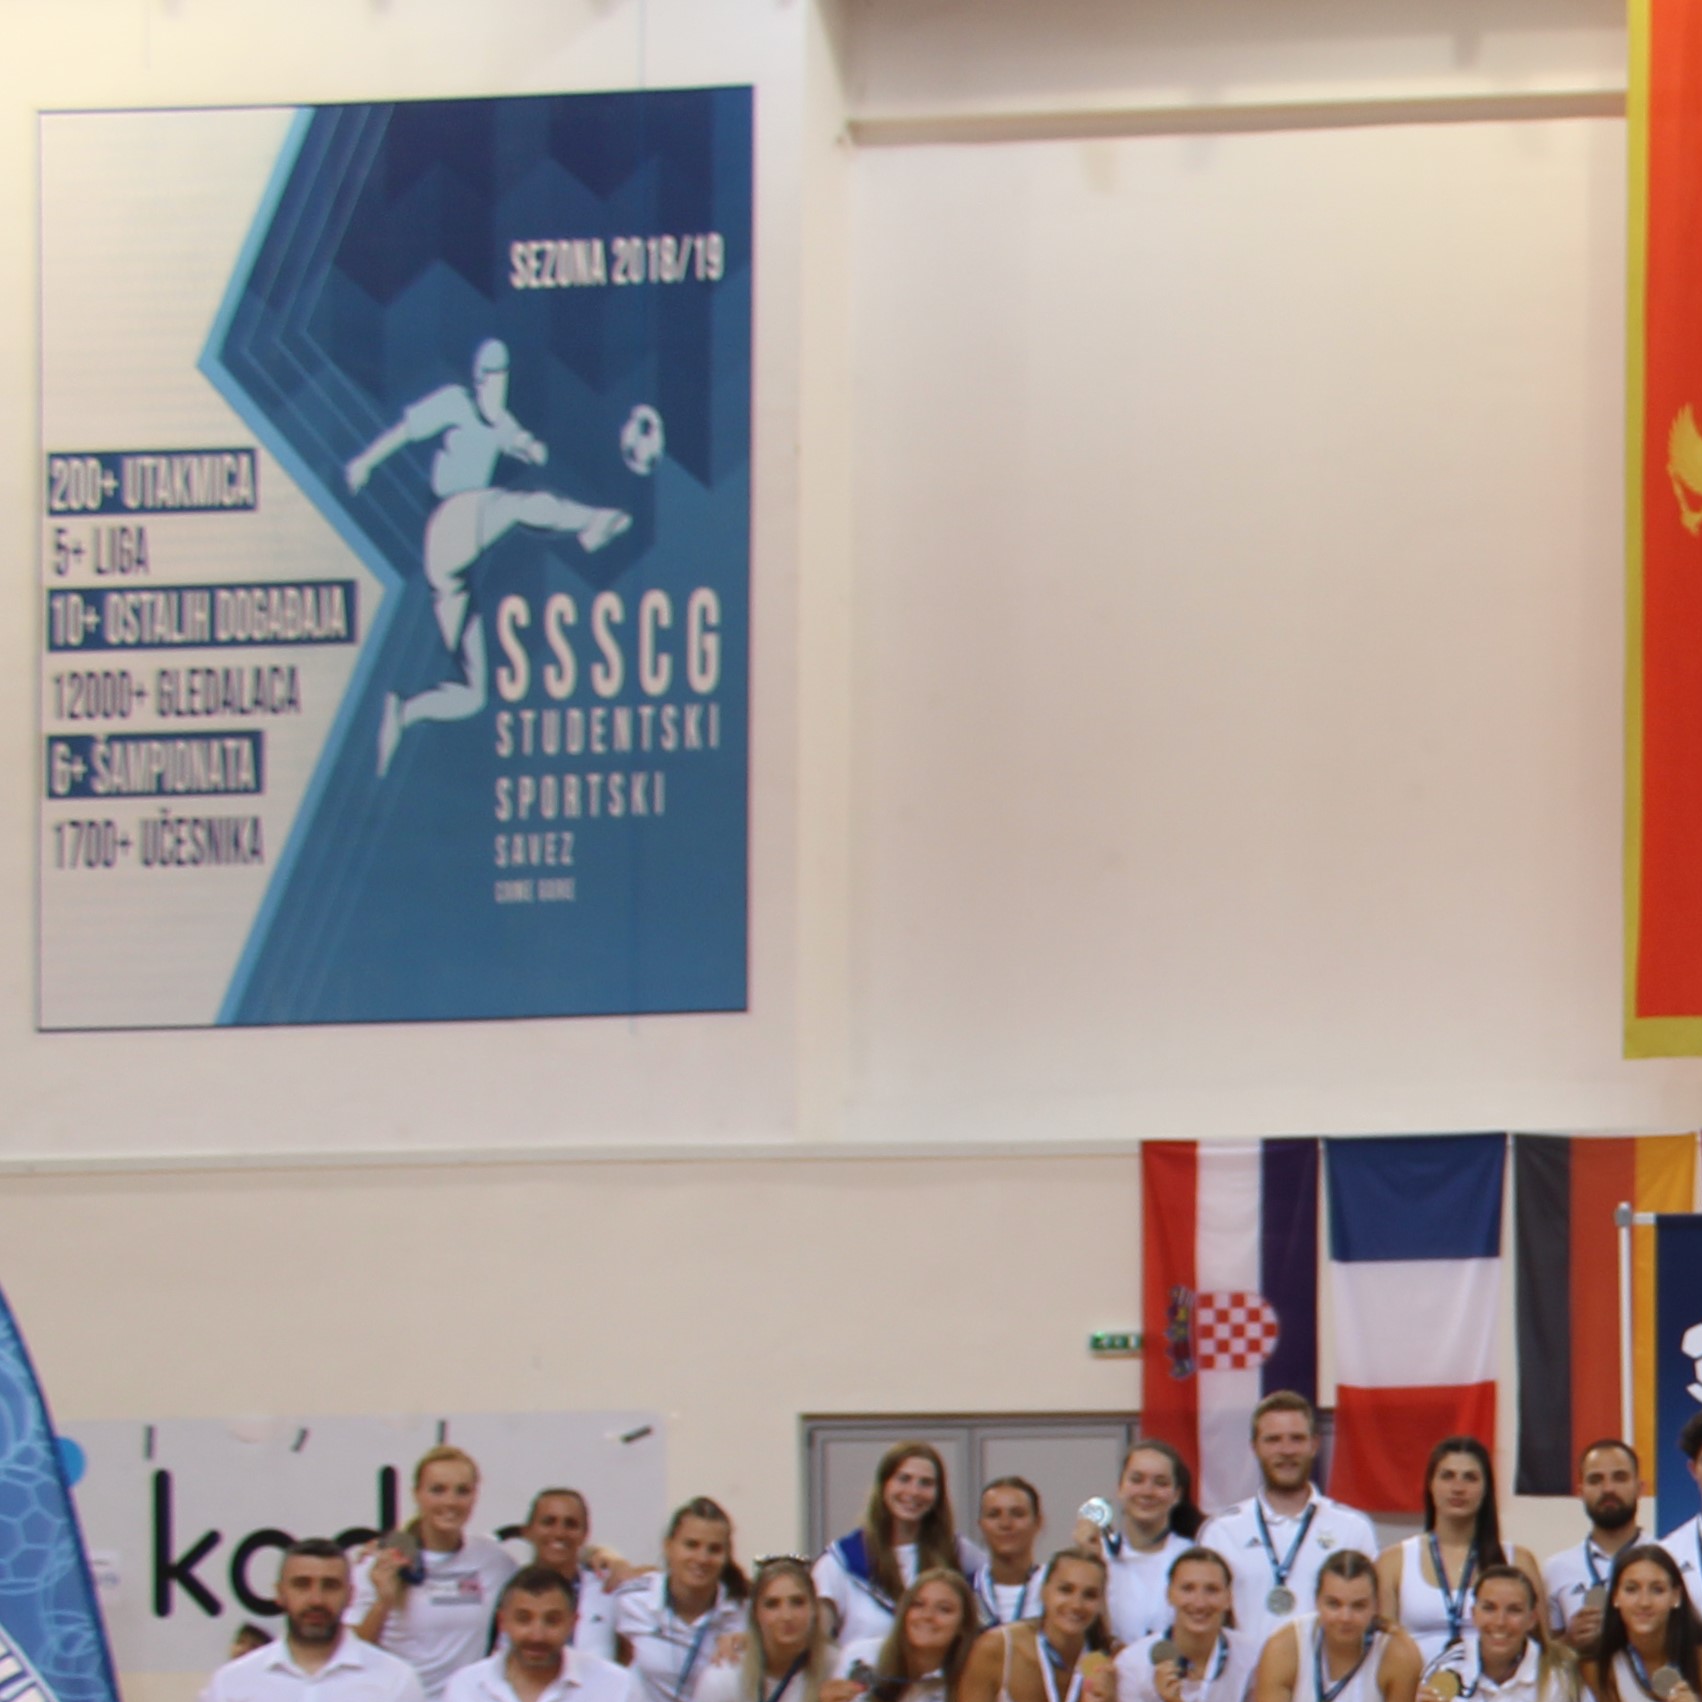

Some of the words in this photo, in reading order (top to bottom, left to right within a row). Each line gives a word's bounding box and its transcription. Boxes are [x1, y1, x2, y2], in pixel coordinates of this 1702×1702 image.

[510, 238, 607, 289] SEZONA
[611, 232, 724, 285] 2018/19
[51, 456, 118, 511] 200+
[122, 452, 255, 508] UTAKMICA
[53, 527, 86, 577] 5+
[94, 525, 150, 576] LIGA
[51, 593, 101, 646] 10+
[103, 588, 211, 644] OSTALIH
[496, 586, 722, 702] SSSCG
[53, 668, 148, 720] 12000+
[495, 702, 720, 758] STUDENTSKI
[51, 741, 88, 796] 6+
[91, 733, 257, 794] ŠAMPIONATA
[494, 771, 666, 822] SPORTSKI
[53, 820, 132, 870] 1700+
[140, 807, 264, 868] UČESNIKA
[494, 831, 575, 868] SAVEZ
